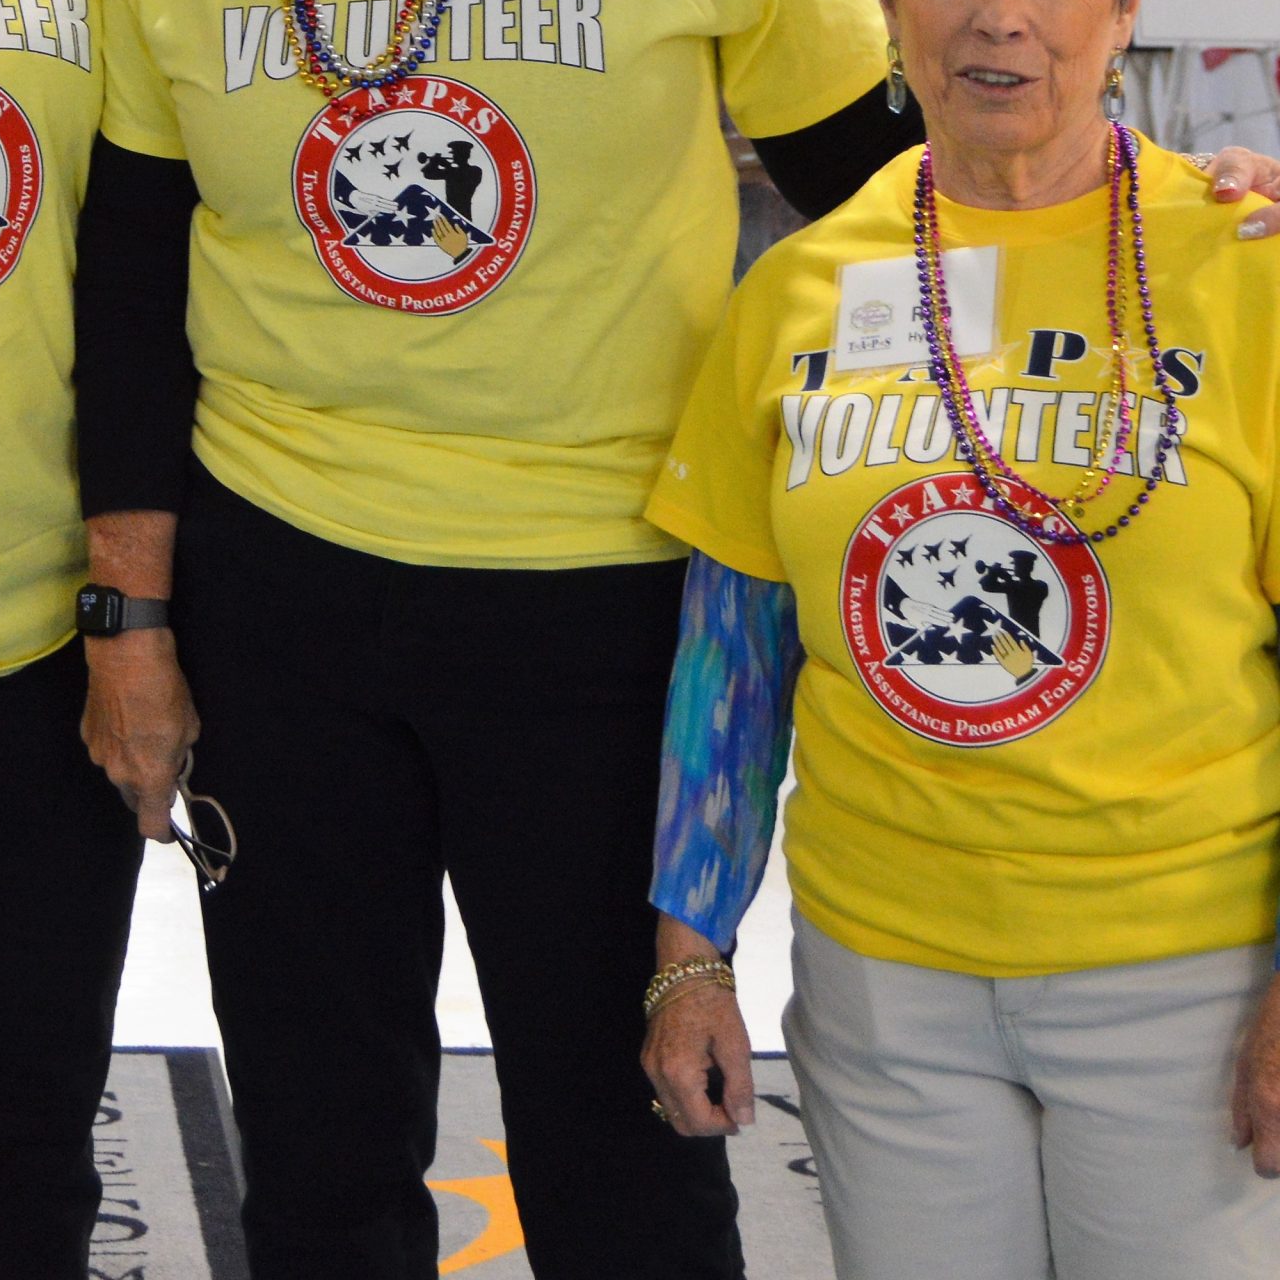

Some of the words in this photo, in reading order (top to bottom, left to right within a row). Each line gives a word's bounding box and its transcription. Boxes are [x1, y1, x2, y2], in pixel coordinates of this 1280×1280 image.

[11, 144, 33, 233] SURVIVORS
[302, 171, 331, 235] TRAGEDY
[324, 239, 397, 308] ASSISTANCE
[401, 282, 479, 310] PROGRAM
[475, 254, 506, 284] FOR
[497, 160, 526, 253] SURVIVORS
[850, 574, 872, 656] TRAGEDY
[865, 660, 951, 733] ASSISTANCE
[955, 704, 1042, 737] PROGRAM
[1041, 678, 1075, 707] FOR
[1066, 573, 1099, 680] SURVIVORS
